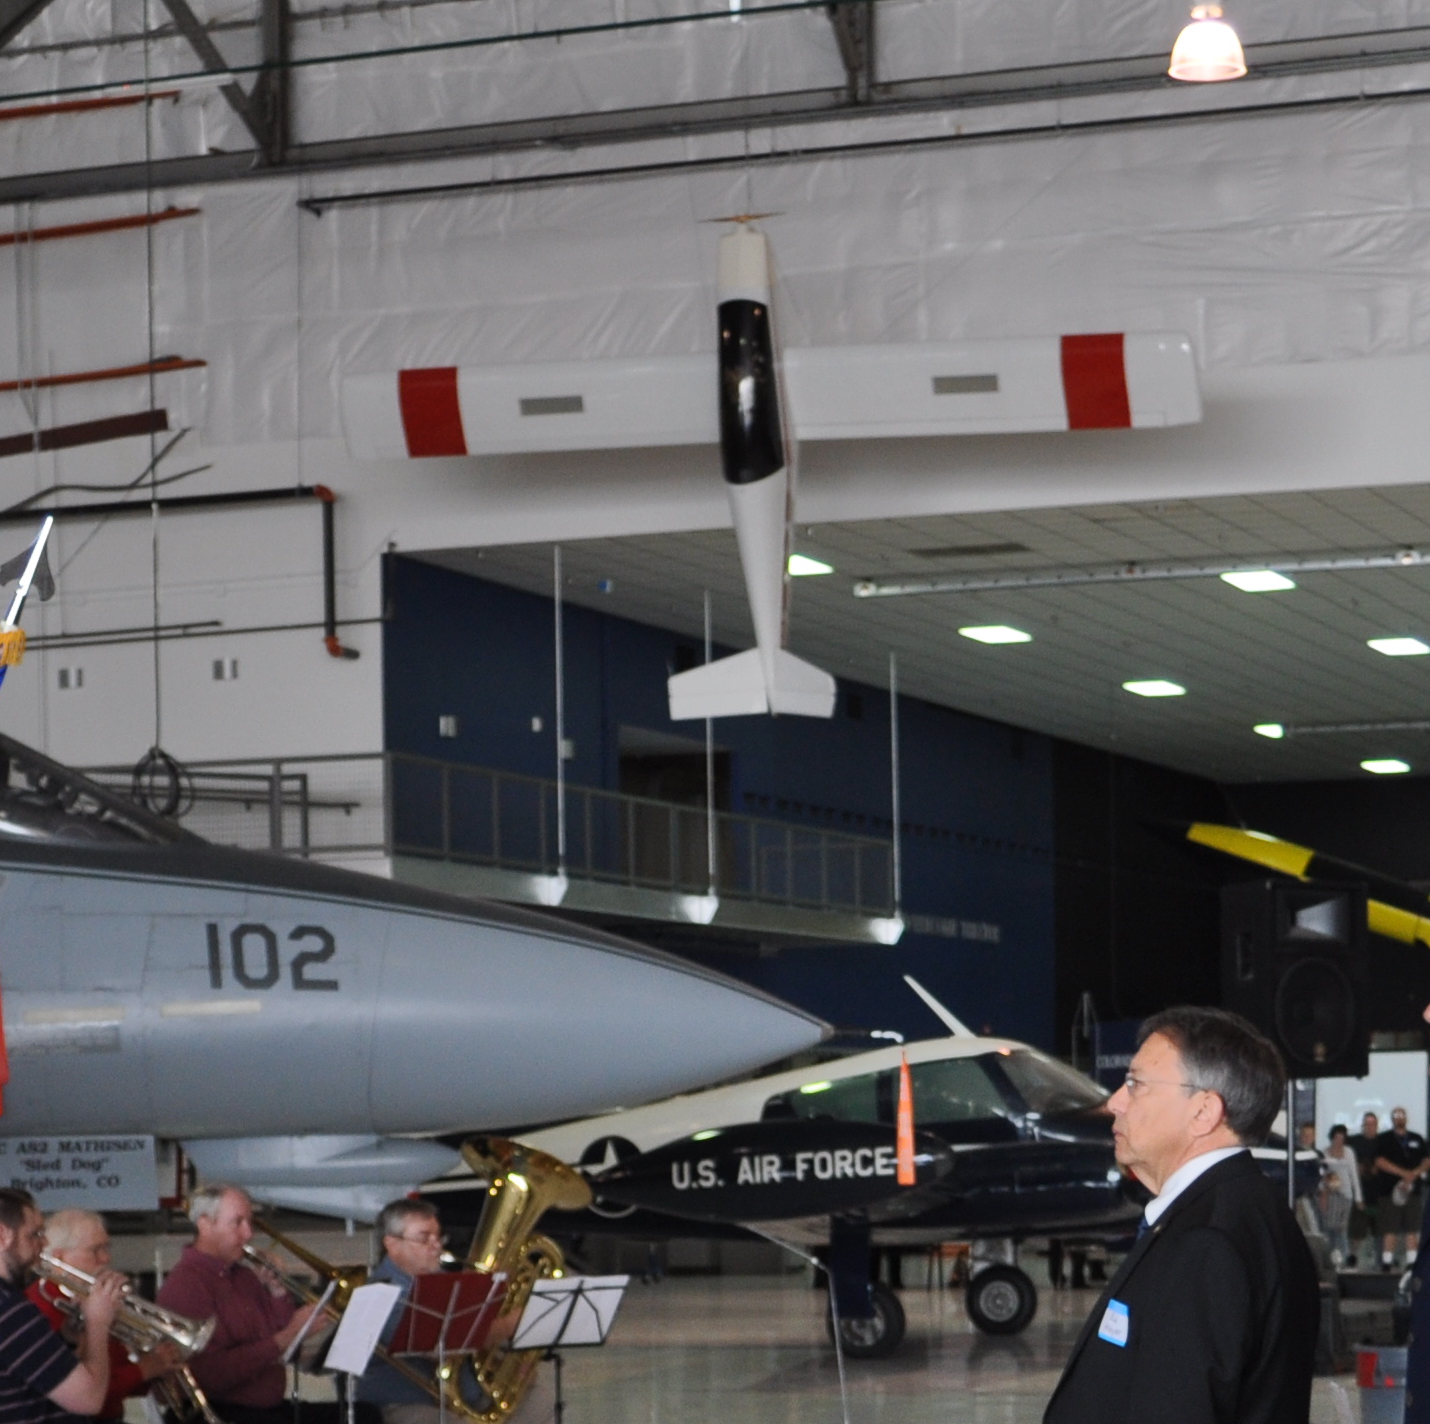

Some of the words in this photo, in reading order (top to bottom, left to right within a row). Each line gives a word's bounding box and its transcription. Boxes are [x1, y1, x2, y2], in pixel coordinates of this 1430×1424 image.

[206, 923, 339, 991] 102
[58, 1138, 146, 1153] MATHISEN
[96, 1175, 121, 1189] CO
[672, 1158, 725, 1190] U.S.
[737, 1154, 782, 1185] AIR
[795, 1147, 895, 1181] FORCE
